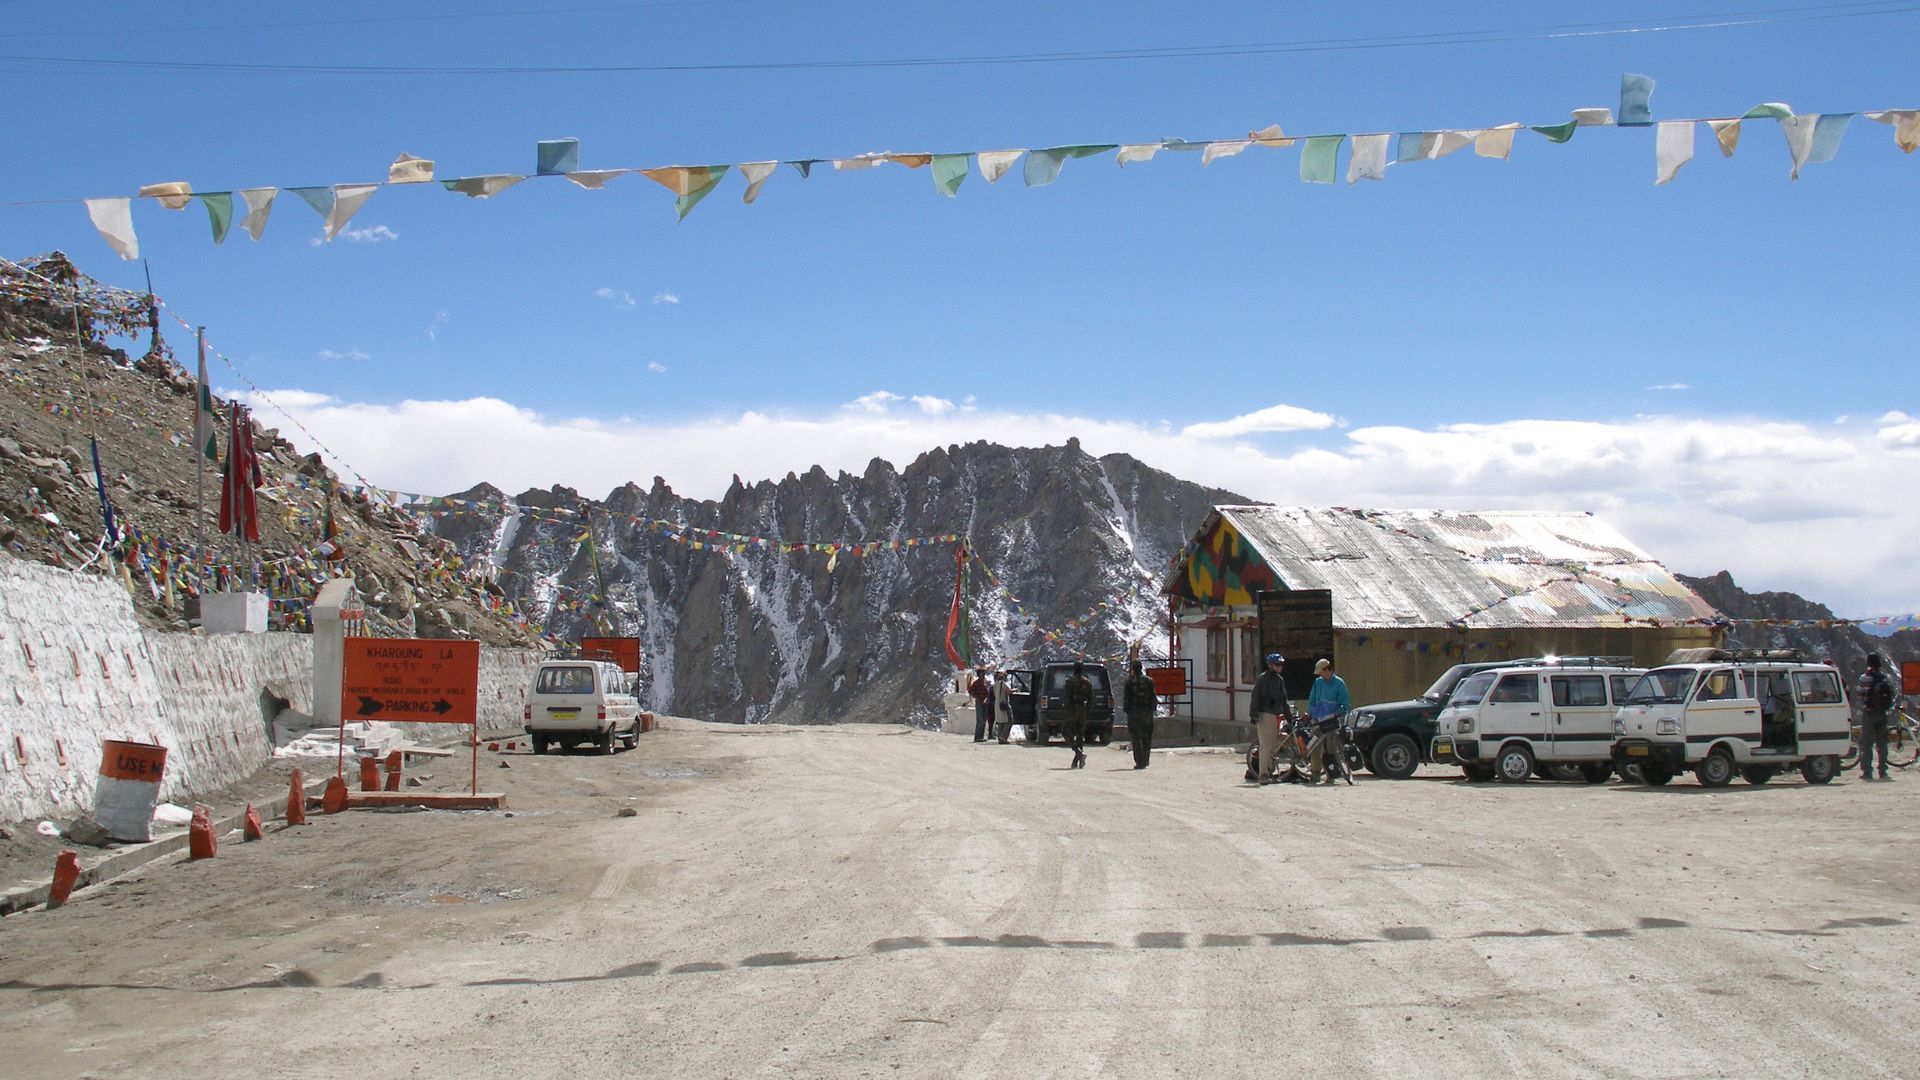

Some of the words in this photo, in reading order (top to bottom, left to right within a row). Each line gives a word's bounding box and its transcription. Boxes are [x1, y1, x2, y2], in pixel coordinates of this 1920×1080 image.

[367, 647, 423, 659] KHARDUNG
[440, 648, 454, 660] LA
[385, 699, 429, 713] PARKING
[117, 753, 147, 774] USE
